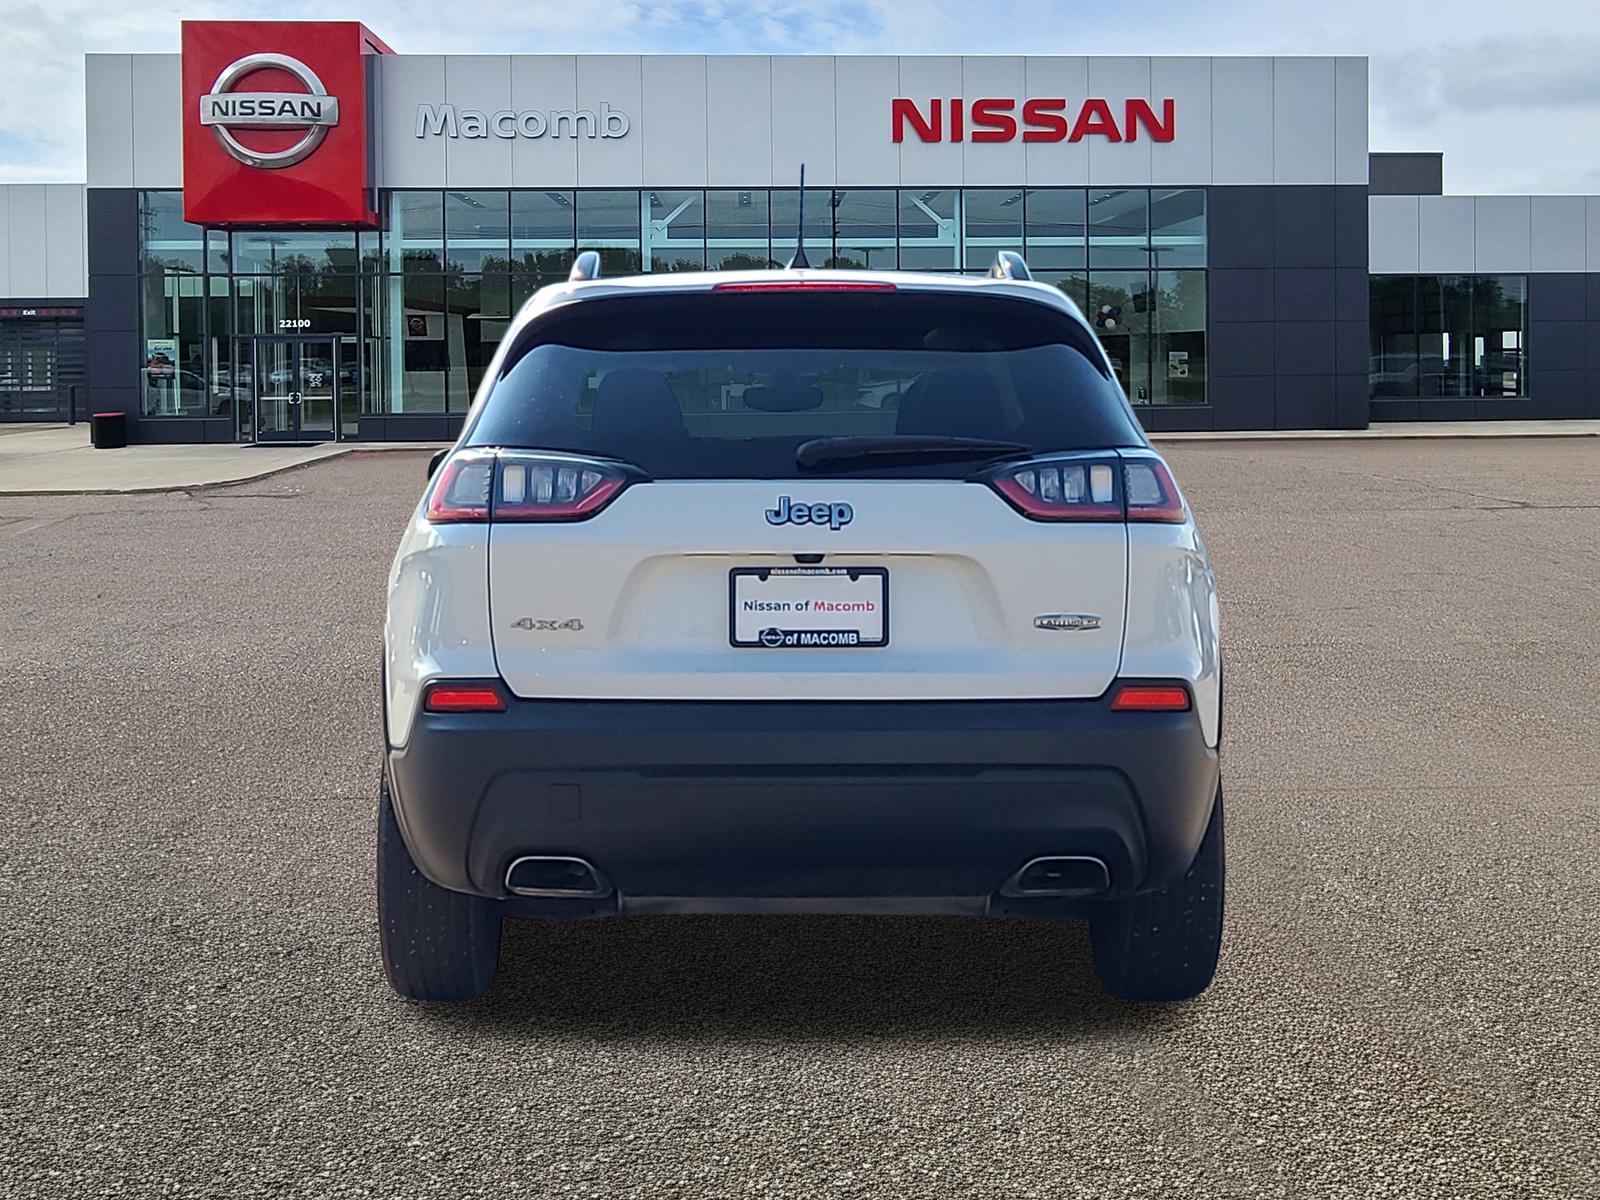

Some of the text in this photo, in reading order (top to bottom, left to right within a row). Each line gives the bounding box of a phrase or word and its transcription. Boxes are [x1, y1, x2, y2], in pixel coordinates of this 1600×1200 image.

[211, 100, 322, 117] NISSAN
[415, 102, 630, 138] Macomb
[892, 98, 1175, 143] NISSAN
[279, 319, 311, 328] 22100
[765, 496, 854, 530] Jeep
[743, 600, 875, 612] Nissan of Macomb
[510, 617, 584, 631] 4x4
[785, 633, 798, 645] of
[800, 633, 858, 645] MACOMB
